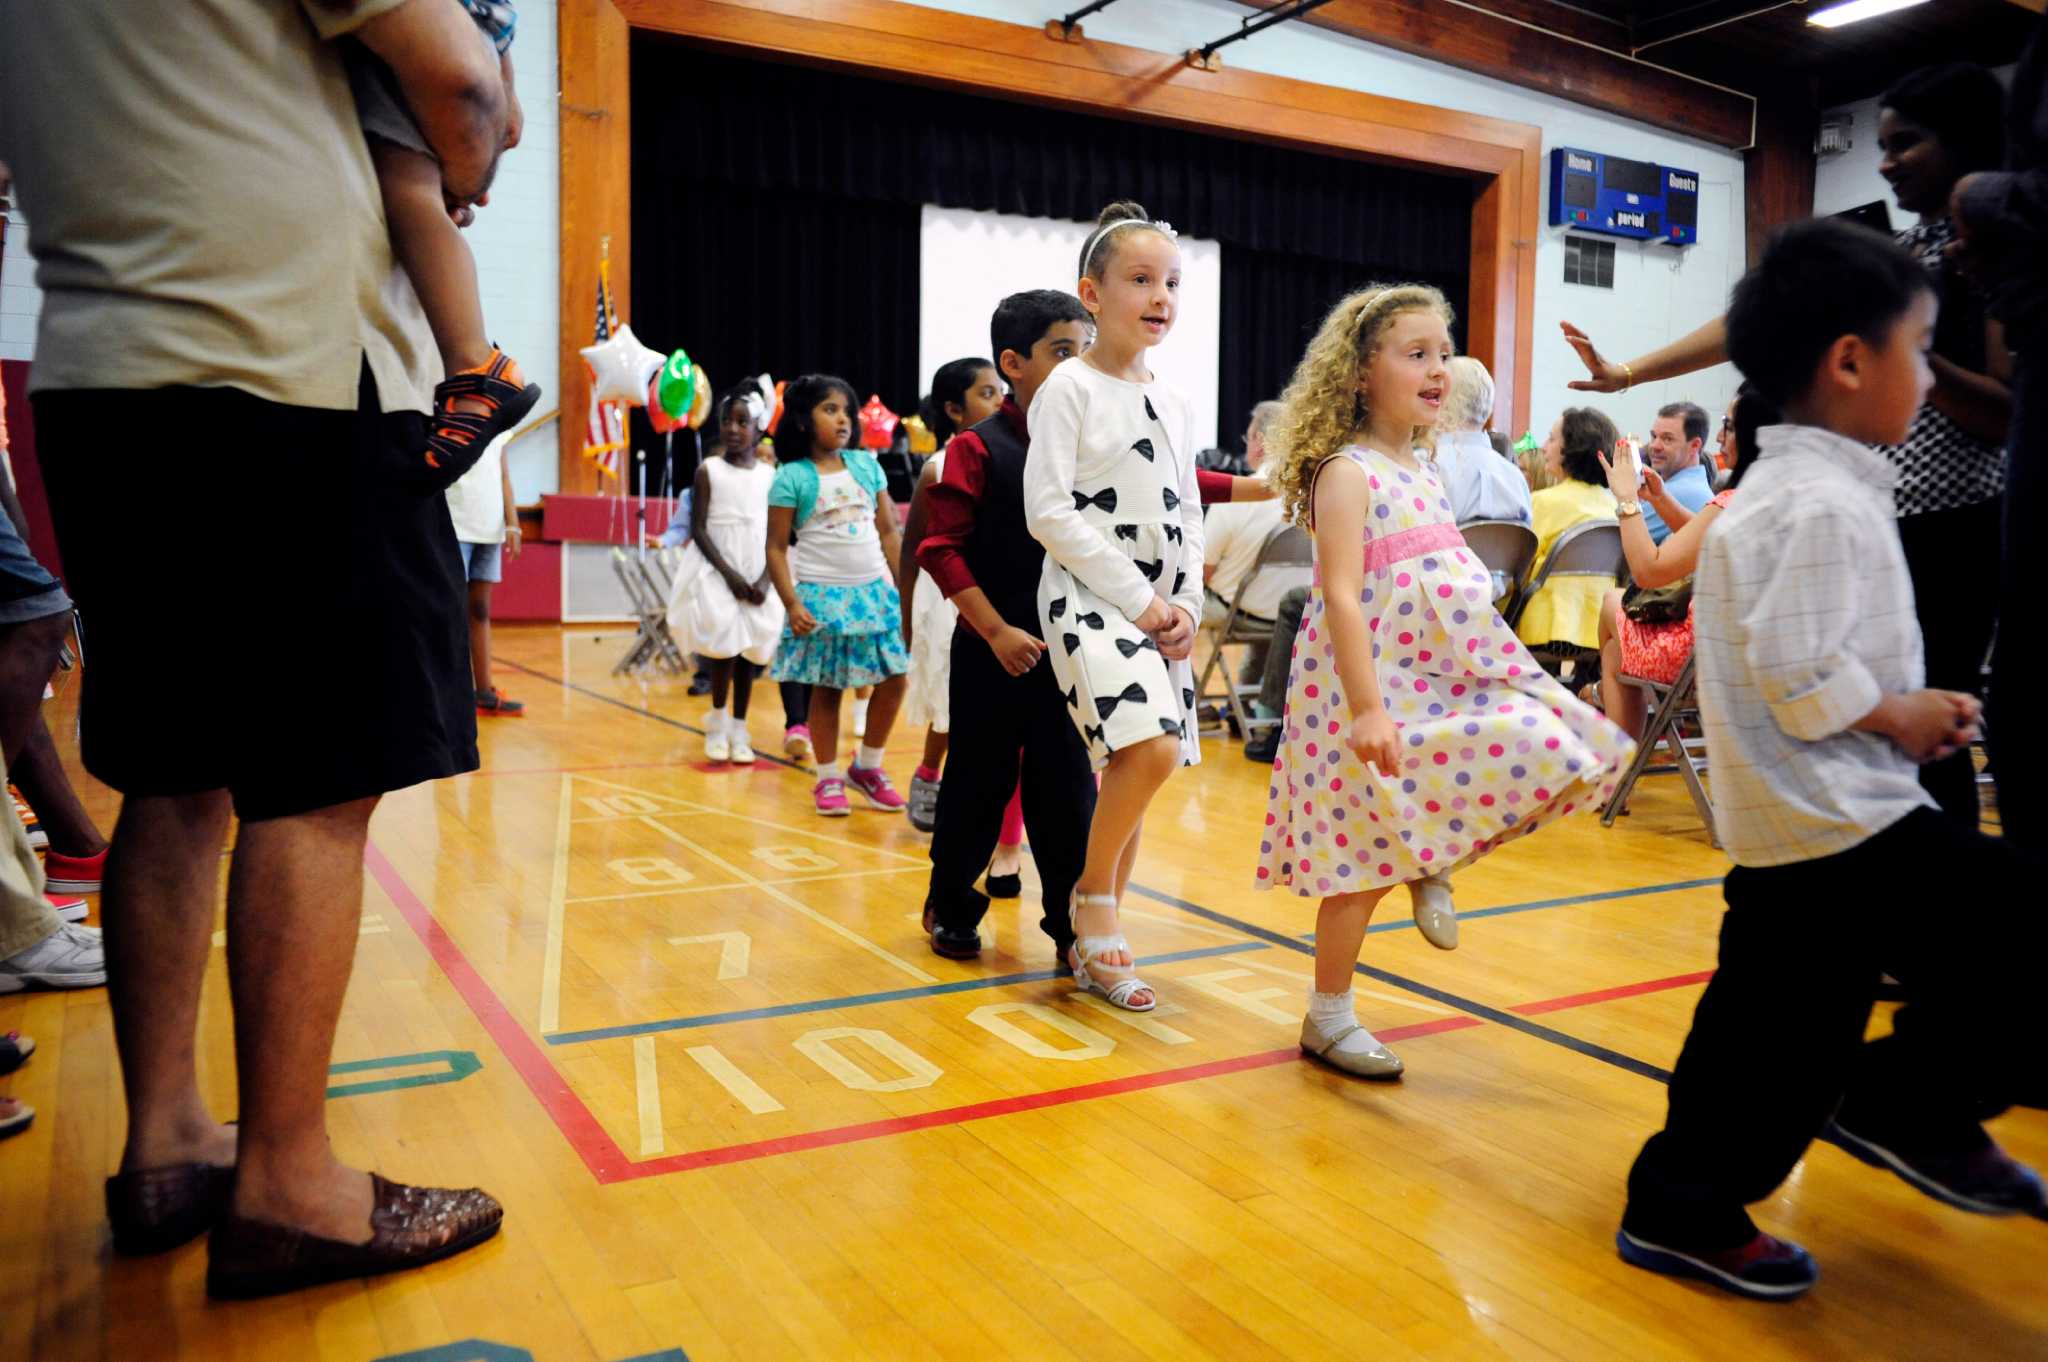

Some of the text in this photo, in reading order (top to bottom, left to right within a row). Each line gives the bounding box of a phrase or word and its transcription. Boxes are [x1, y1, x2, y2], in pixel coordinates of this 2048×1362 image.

[1568, 153, 1592, 172] Home
[1669, 173, 1696, 192] Guests
[1617, 211, 1645, 228] period
[750, 846, 839, 873] 8
[606, 857, 696, 886] 8
[667, 931, 752, 981] 7
